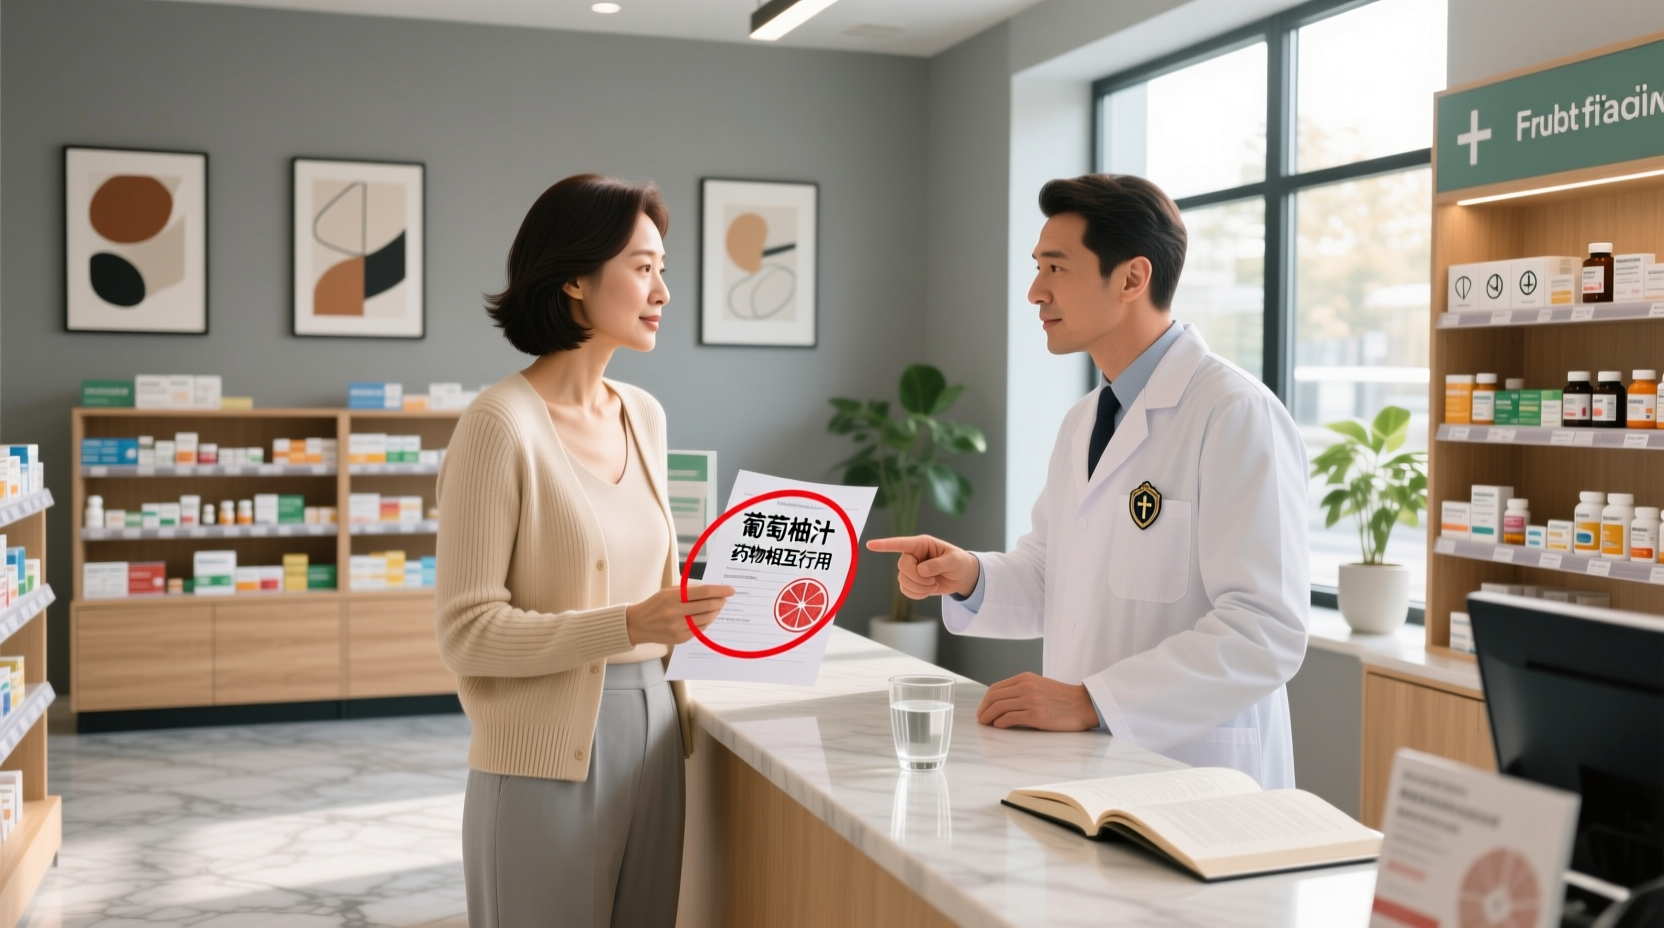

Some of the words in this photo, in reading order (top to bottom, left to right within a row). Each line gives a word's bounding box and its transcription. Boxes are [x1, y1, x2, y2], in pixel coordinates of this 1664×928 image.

[1516, 102, 1579, 142] Frubt
[742, 511, 836, 545] 葡萄柚汁
[730, 543, 833, 571] 药物相互行用
